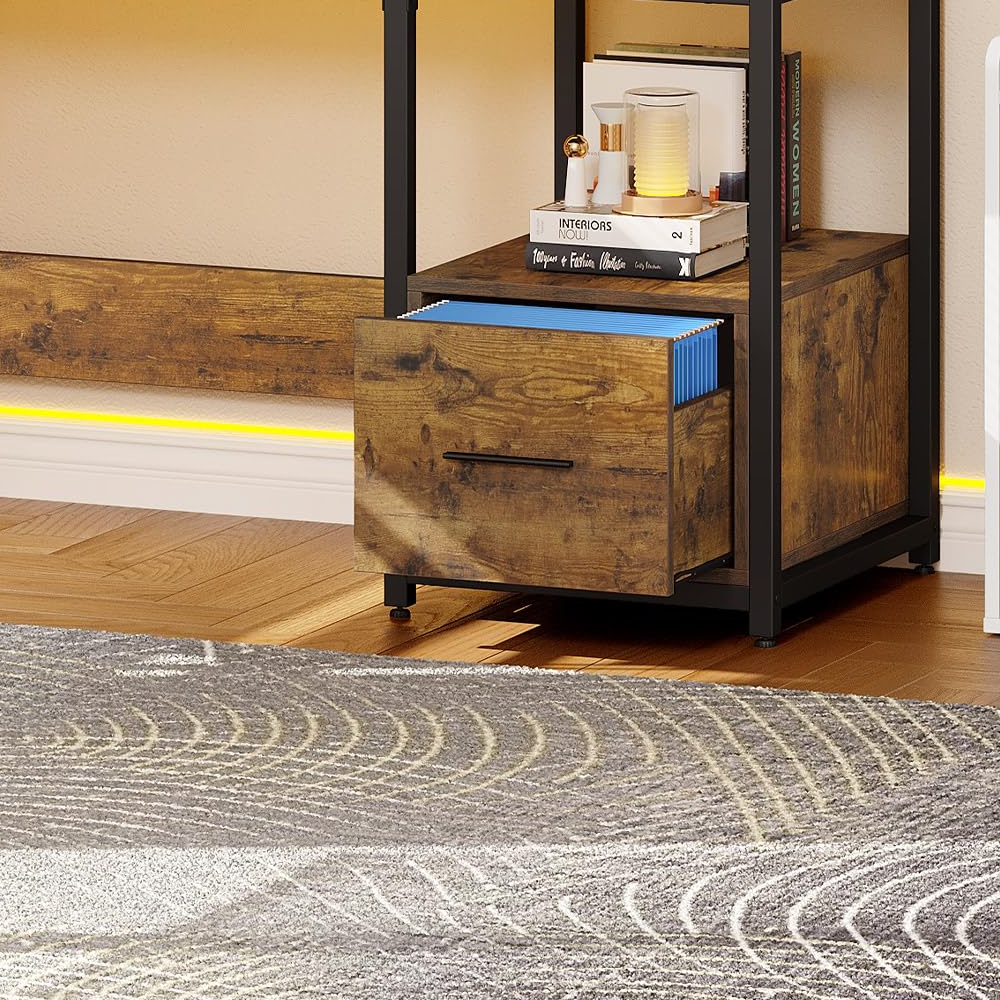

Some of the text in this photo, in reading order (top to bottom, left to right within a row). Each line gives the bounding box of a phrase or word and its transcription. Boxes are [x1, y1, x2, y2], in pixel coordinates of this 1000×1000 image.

[791, 119, 800, 218] WOMEN
[559, 217, 612, 232] INTERIORS
[558, 229, 589, 241] NOW!
[671, 231, 683, 239] 2
[570, 251, 595, 269] Fashion
